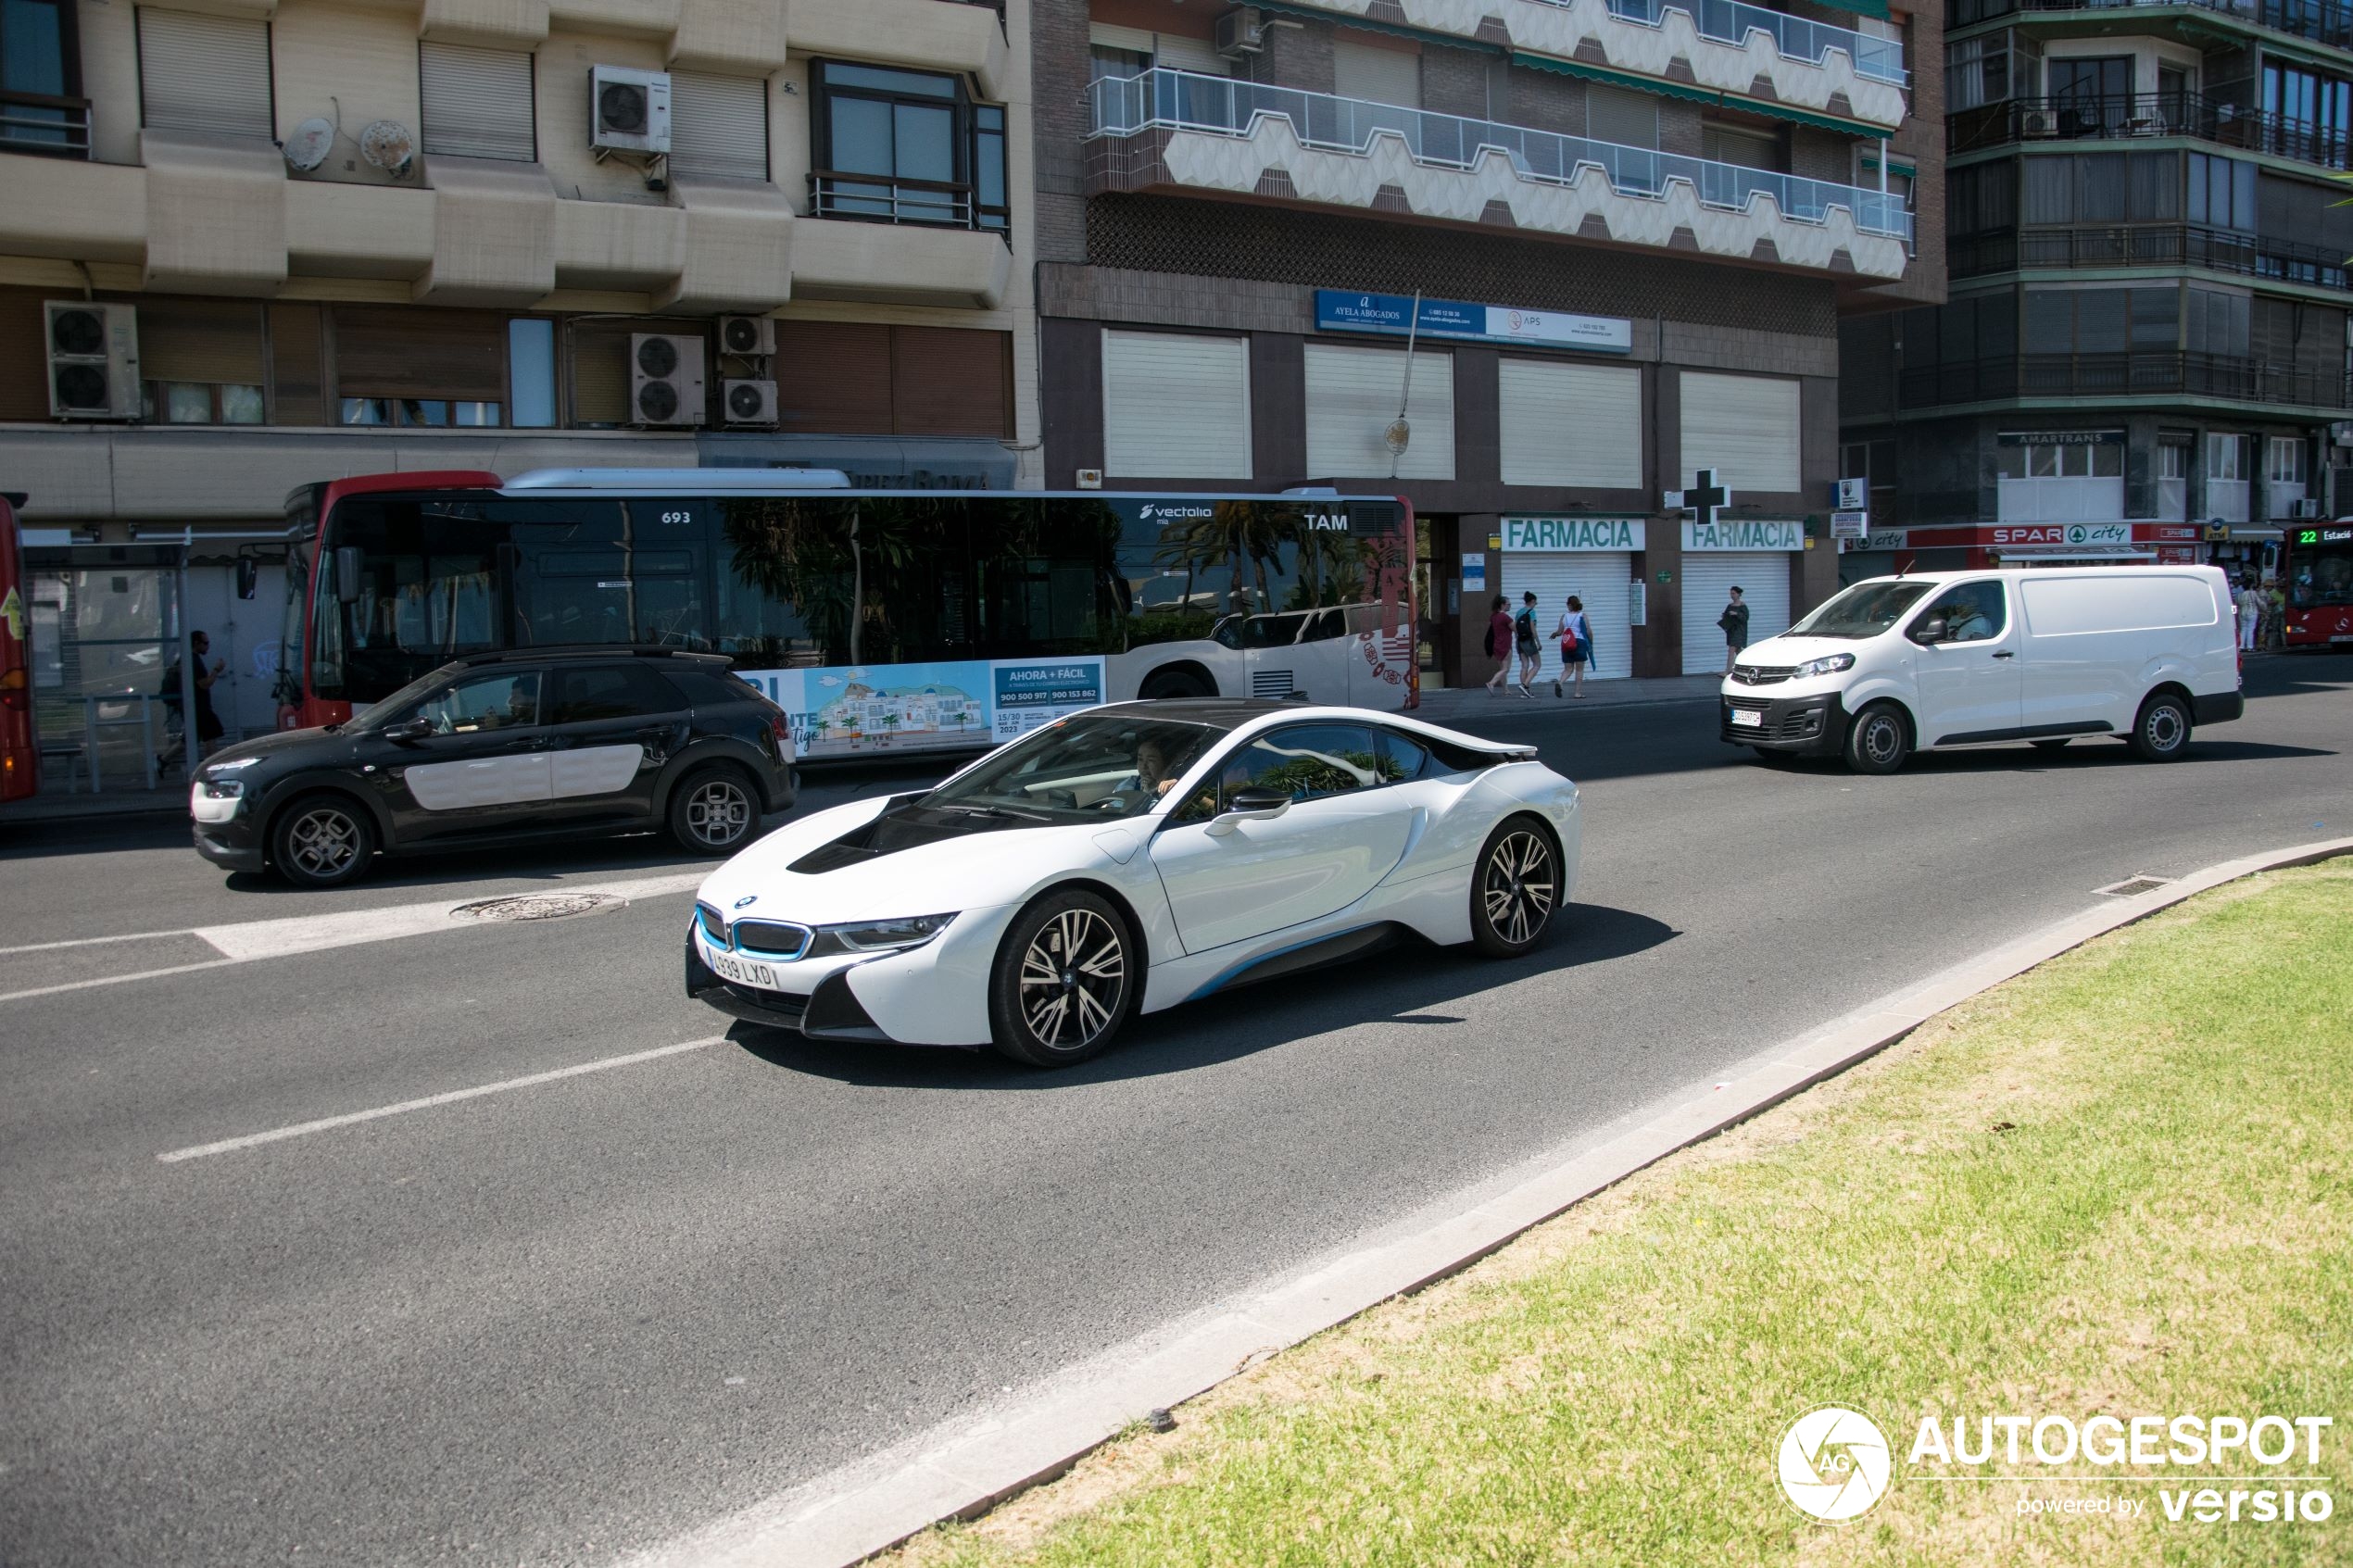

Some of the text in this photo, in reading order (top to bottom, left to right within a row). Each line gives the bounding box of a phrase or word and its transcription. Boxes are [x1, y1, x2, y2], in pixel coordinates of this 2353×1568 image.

[1335, 307, 1400, 320] AYELA ABOGADOS
[1524, 317, 1541, 326] APS
[2019, 433, 2103, 444] AMARTRANS
[661, 512, 691, 524] 693
[1155, 507, 1212, 517] vectalia
[1303, 514, 1348, 531] TAM
[1508, 520, 1633, 547] FARMACIA
[1692, 521, 1797, 547] FARMACIA
[1875, 532, 1903, 548] city
[1993, 524, 2126, 543] SPAR city
[2300, 531, 2317, 543] 22
[1009, 670, 1048, 682] AHORA
[1058, 668, 1086, 679] FÁCIL
[998, 713, 1020, 721] 15/30
[713, 953, 772, 985] 4939 LXD
